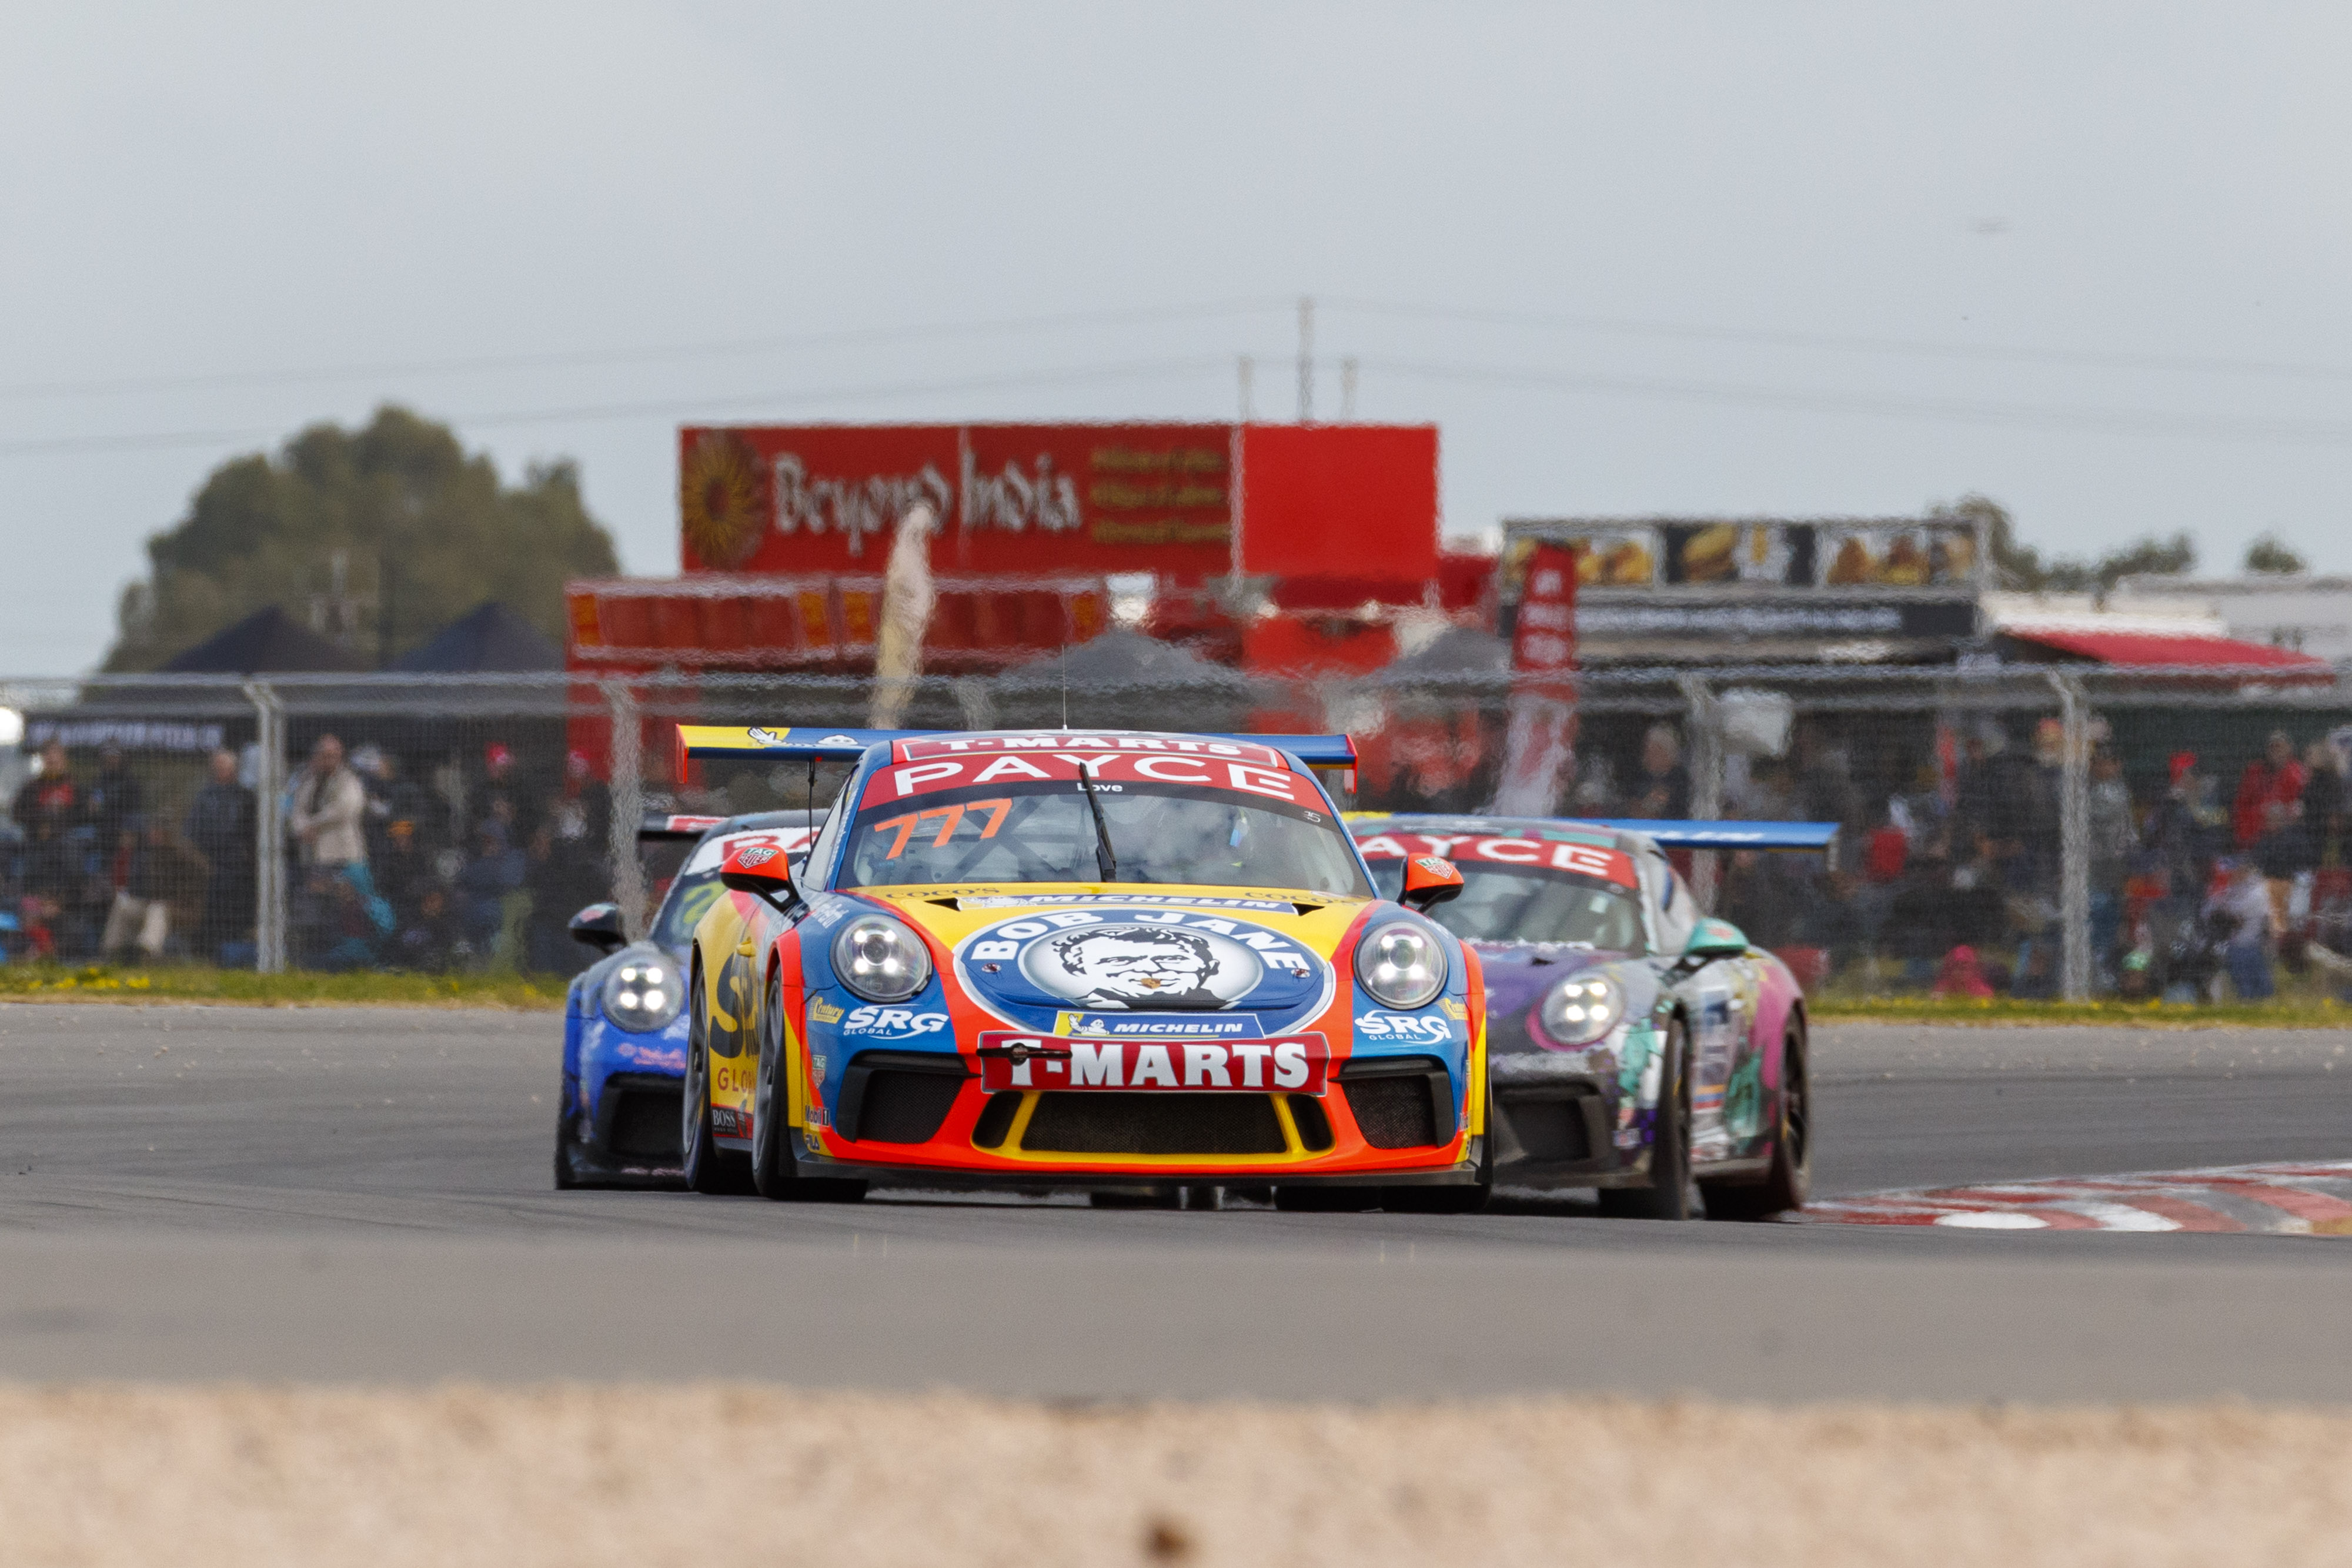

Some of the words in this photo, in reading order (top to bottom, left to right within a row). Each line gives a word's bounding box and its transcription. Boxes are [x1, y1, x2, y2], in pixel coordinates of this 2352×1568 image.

[941, 737, 1242, 755] T-MARTS
[894, 754, 1295, 801] PAYCE
[874, 798, 1014, 860] 777
[746, 847, 775, 855] TAG
[1358, 835, 1613, 876] AYCE
[886, 887, 1000, 899] COCO'S
[1030, 895, 1280, 908] MICHELIN
[971, 911, 1104, 960] BOB
[1134, 911, 1312, 970] JANE
[843, 1004, 950, 1039] SRG
[843, 1028, 893, 1036] GLOBAL
[1114, 1022, 1242, 1033] MICHELIN
[1354, 1009, 1452, 1044] SRG
[1000, 1038, 1309, 1088] T-MARTS
[713, 1109, 736, 1127] BOSS
